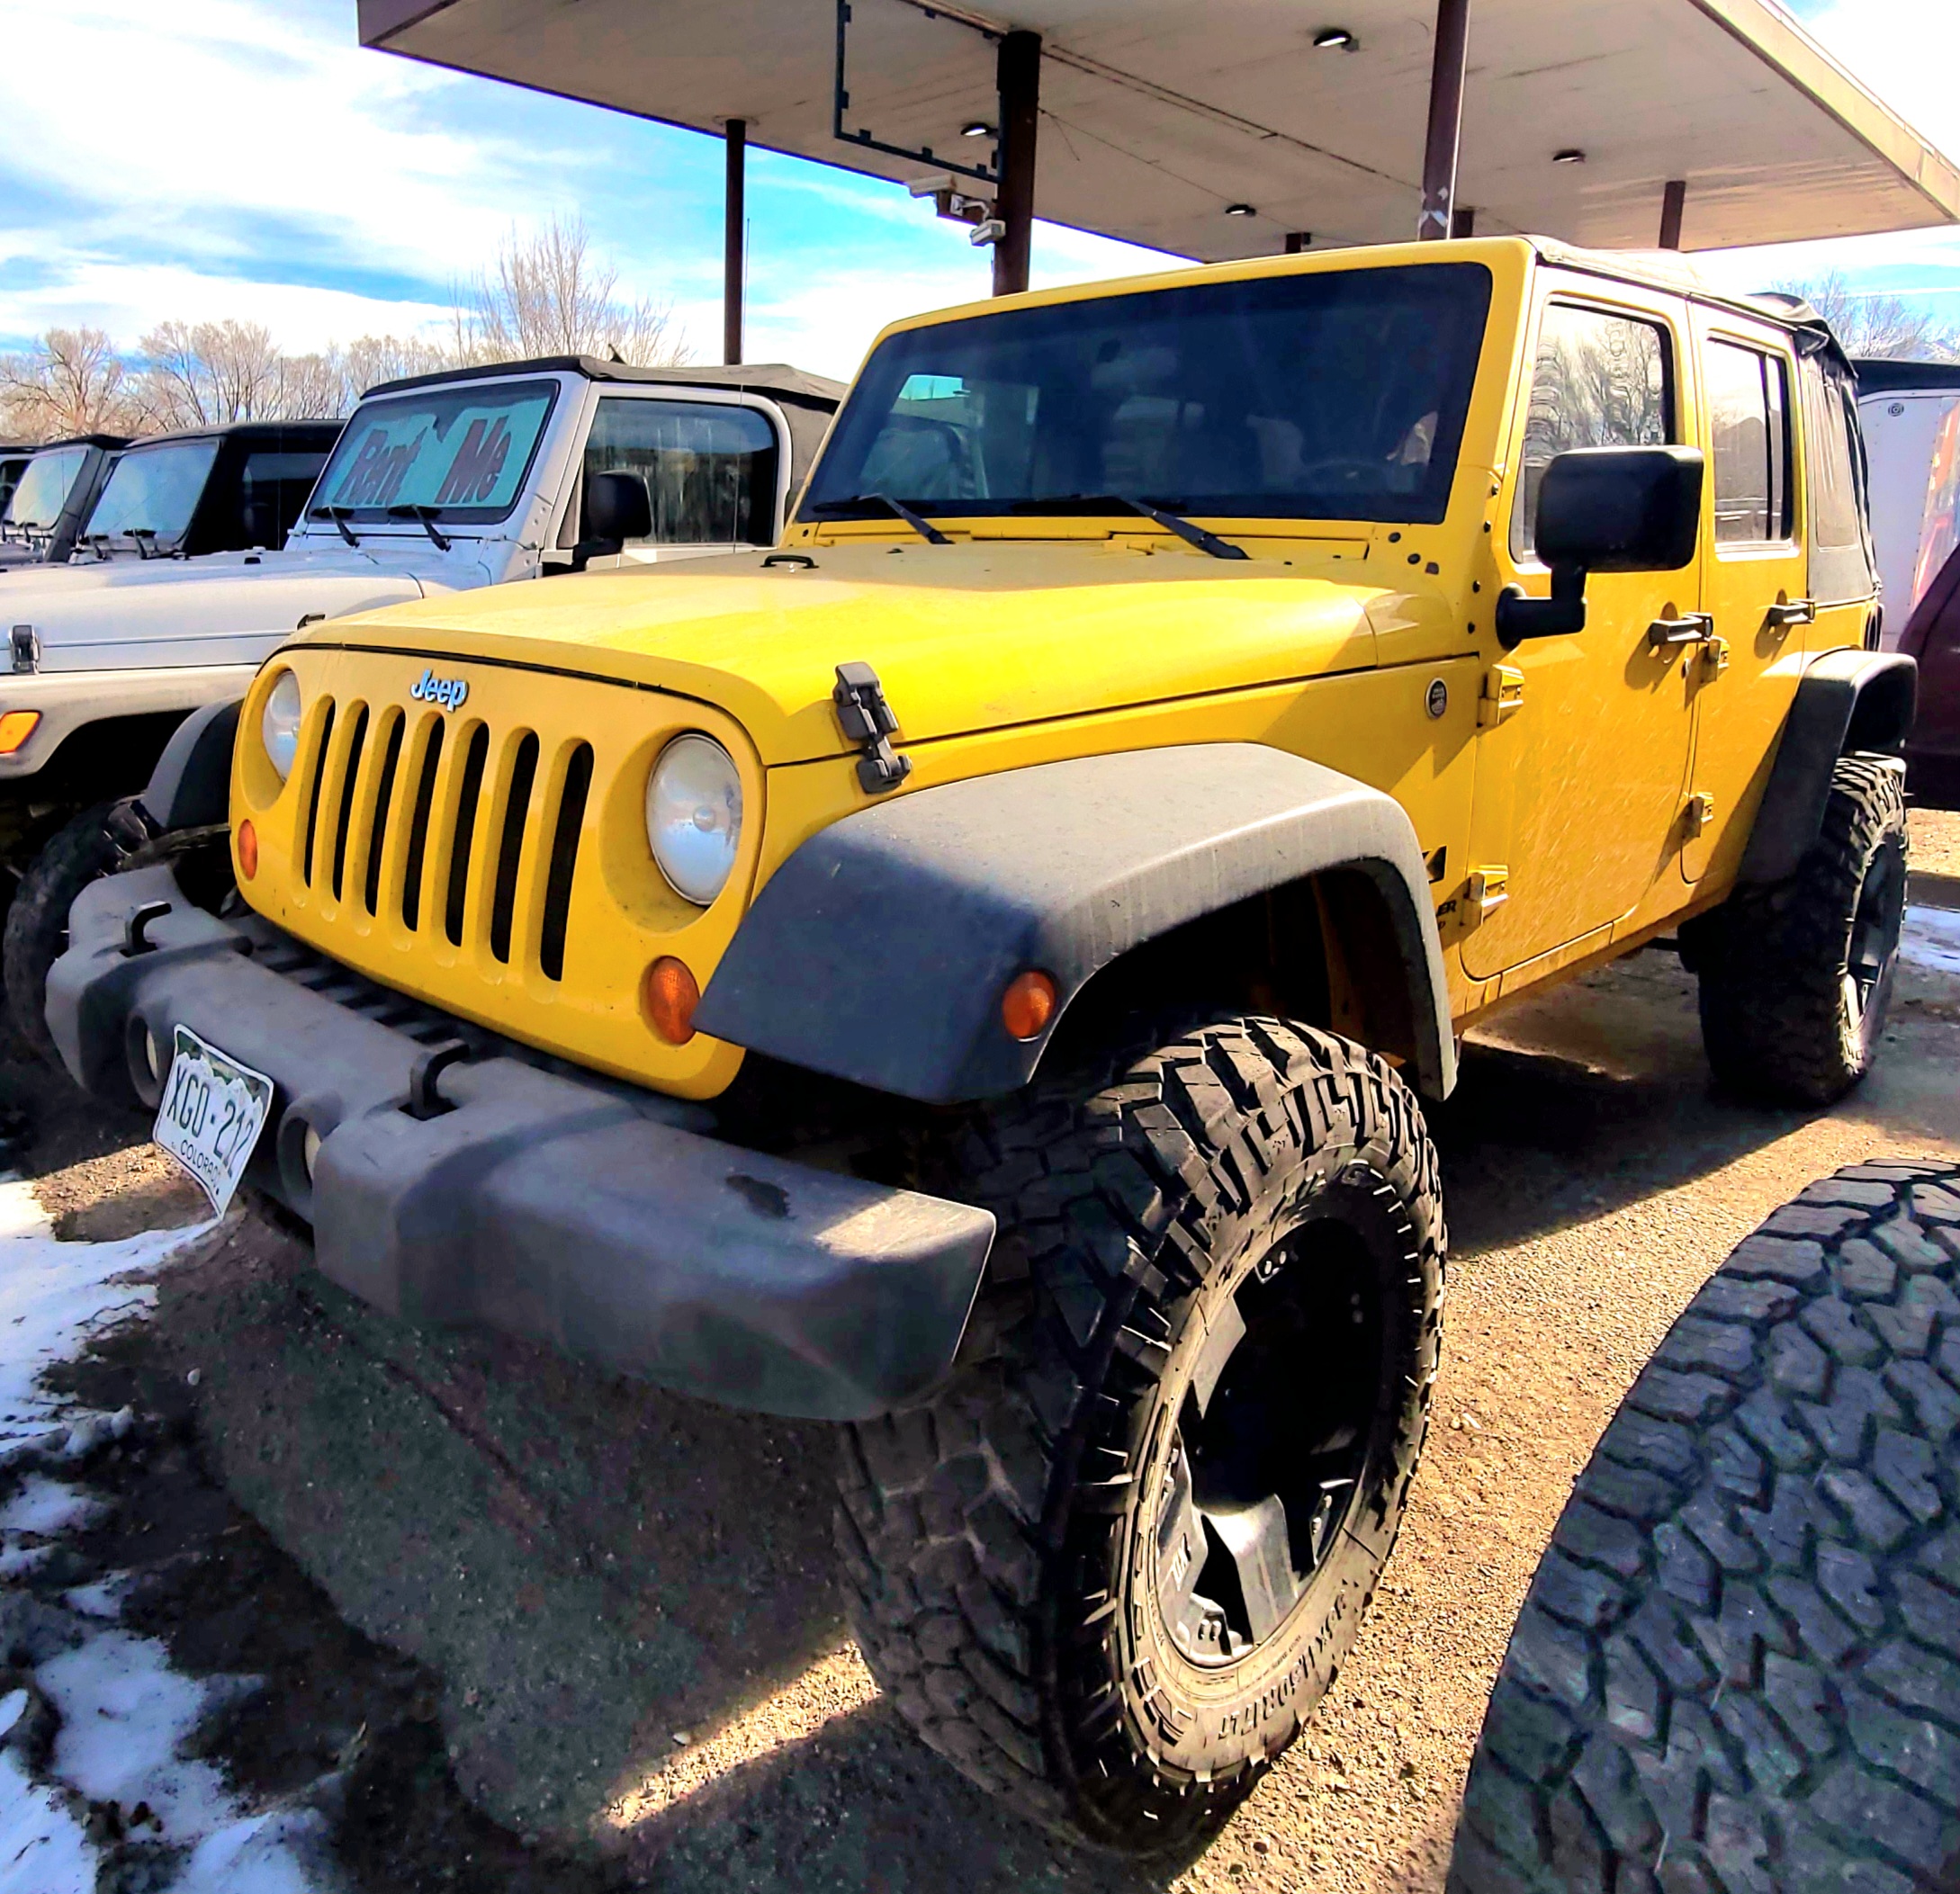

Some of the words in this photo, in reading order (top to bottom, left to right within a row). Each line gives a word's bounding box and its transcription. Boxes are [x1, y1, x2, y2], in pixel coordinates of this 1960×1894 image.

[331, 426, 427, 505] Rent
[434, 415, 511, 504] Me
[411, 669, 468, 712] Jeep
